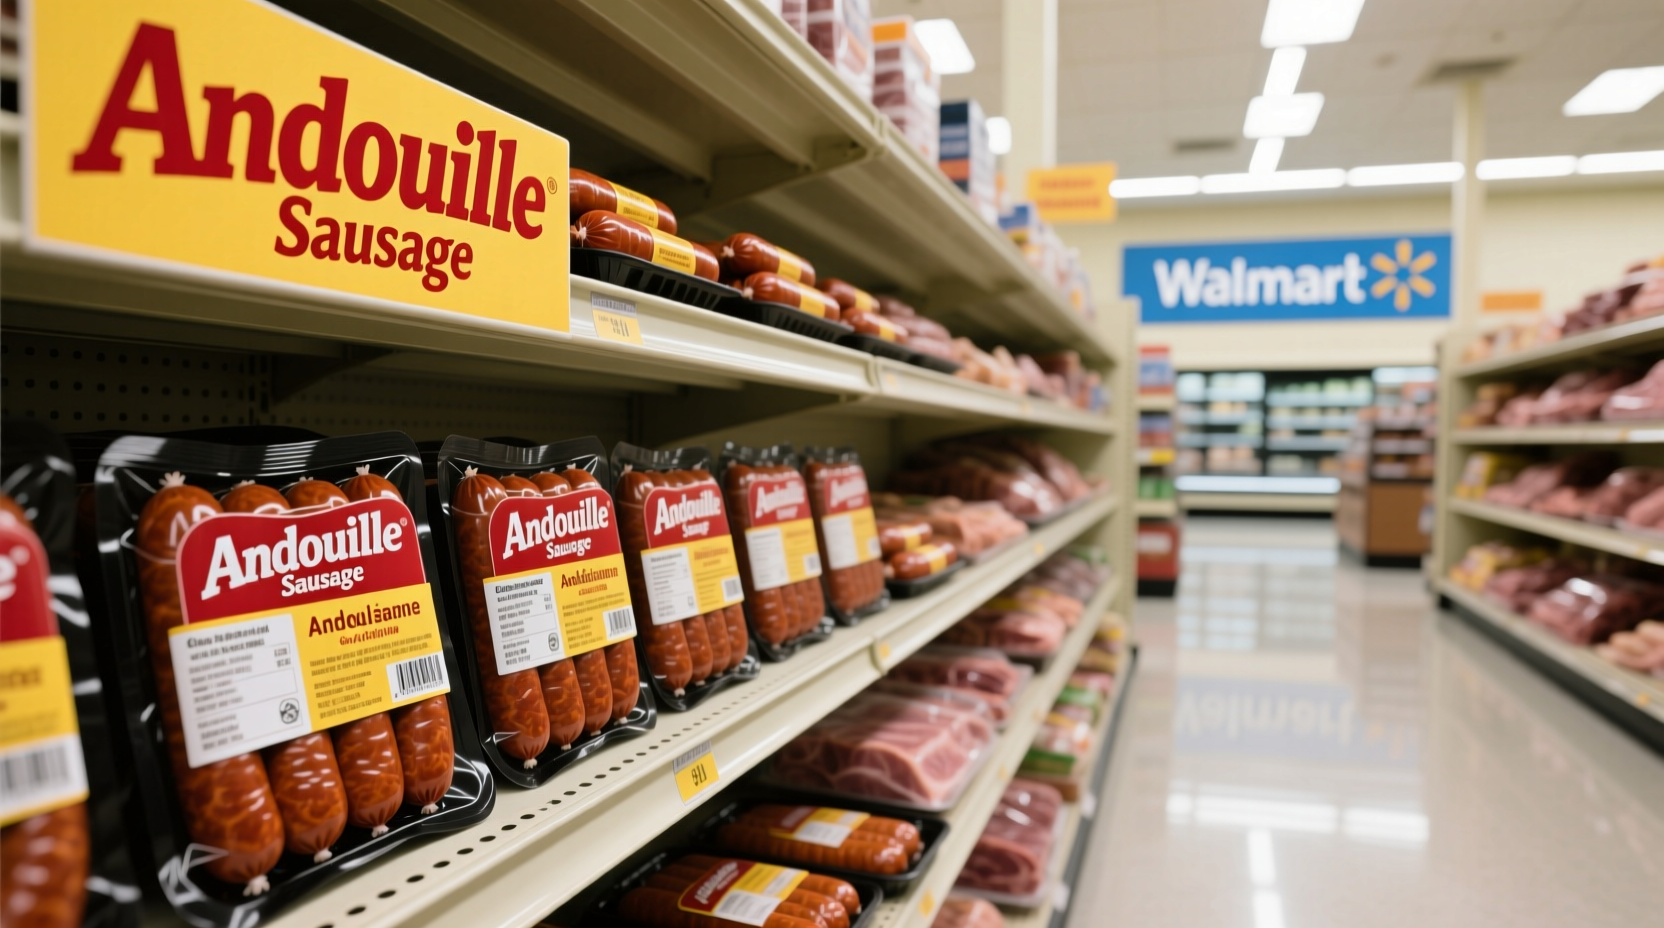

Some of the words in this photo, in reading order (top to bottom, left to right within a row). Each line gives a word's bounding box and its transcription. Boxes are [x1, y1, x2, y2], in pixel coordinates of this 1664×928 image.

[71, 20, 546, 240] Andouille
[274, 195, 473, 292] Sausage
[1153, 252, 1367, 308] Walmart
[201, 510, 402, 600] Andouille
[503, 496, 609, 560] Andouille
[281, 566, 364, 597] Sausage
